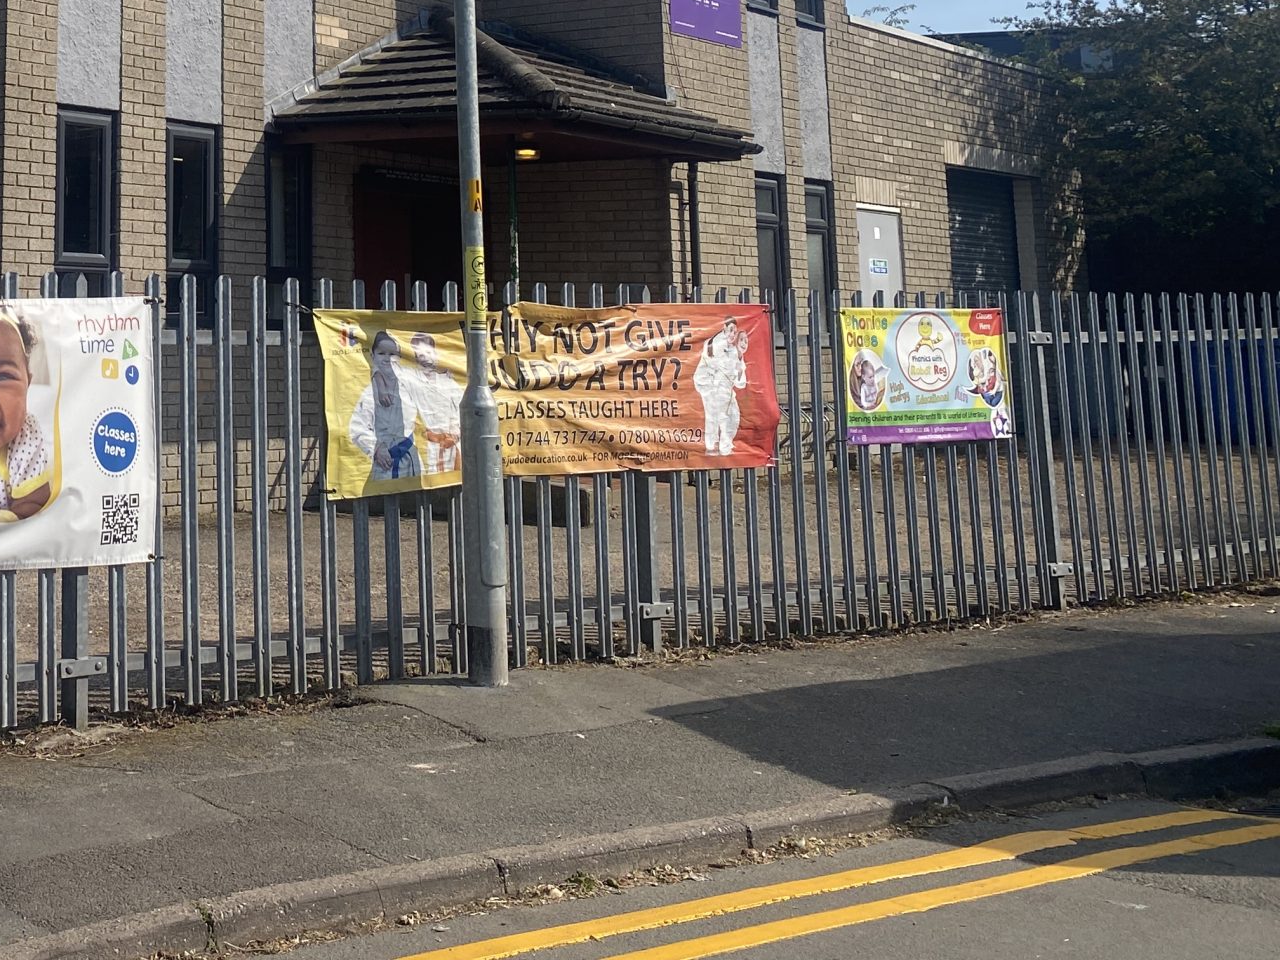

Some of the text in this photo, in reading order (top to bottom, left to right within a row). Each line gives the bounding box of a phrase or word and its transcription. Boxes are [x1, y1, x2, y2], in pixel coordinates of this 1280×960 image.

[76, 313, 140, 336] rhythm
[844, 314, 888, 330] Phonics
[80, 336, 114, 354] time
[458, 318, 693, 354] HY NOT GIVE
[846, 332, 878, 348] Class
[586, 360, 606, 390] A
[618, 358, 682, 390] TRY?
[934, 366, 948, 377] Reg
[498, 400, 680, 420] CLASSES TAUGHT HERE
[506, 428, 702, 446] 01744 731747 07801816629
[104, 441, 126, 458] here
[593, 452, 608, 462] FOR
